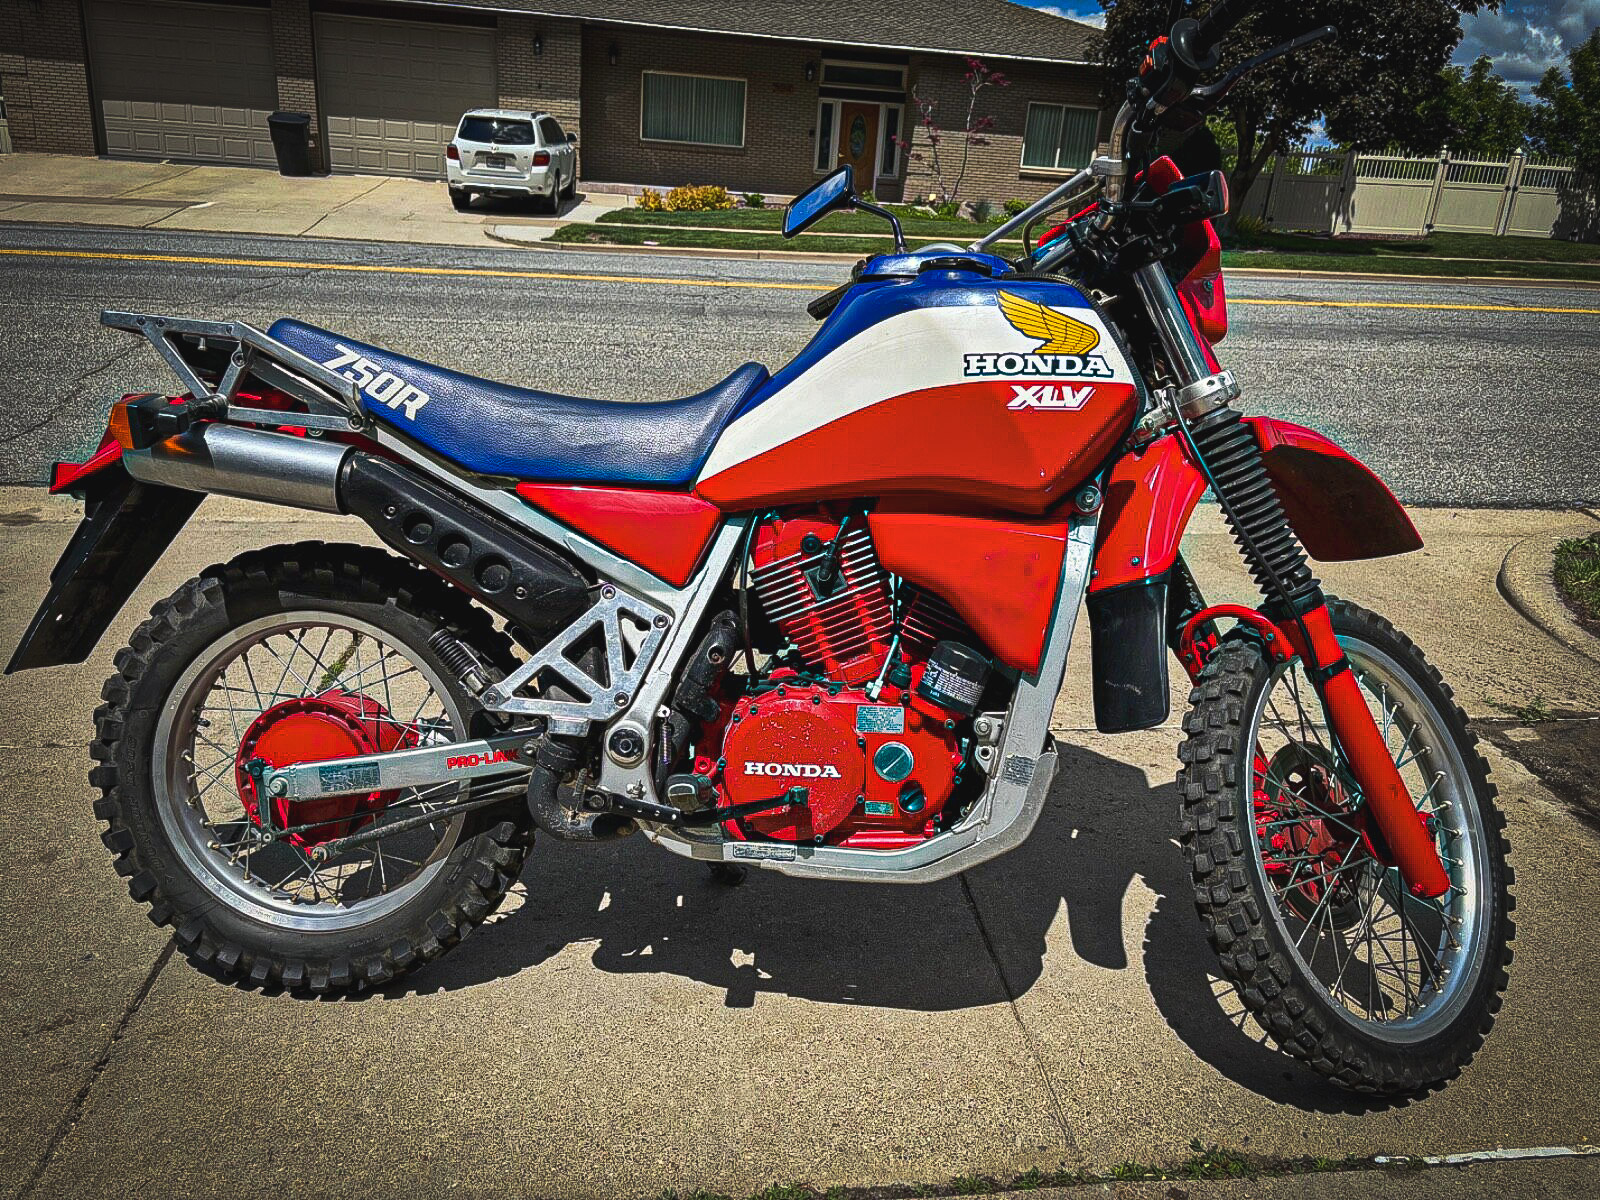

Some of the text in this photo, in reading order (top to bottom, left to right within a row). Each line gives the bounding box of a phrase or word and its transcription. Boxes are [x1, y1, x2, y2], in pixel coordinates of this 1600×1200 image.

[964, 352, 1115, 378] HONDA
[322, 343, 430, 421] 750R
[1006, 384, 1097, 411] XLV
[744, 761, 842, 779] HONDA
